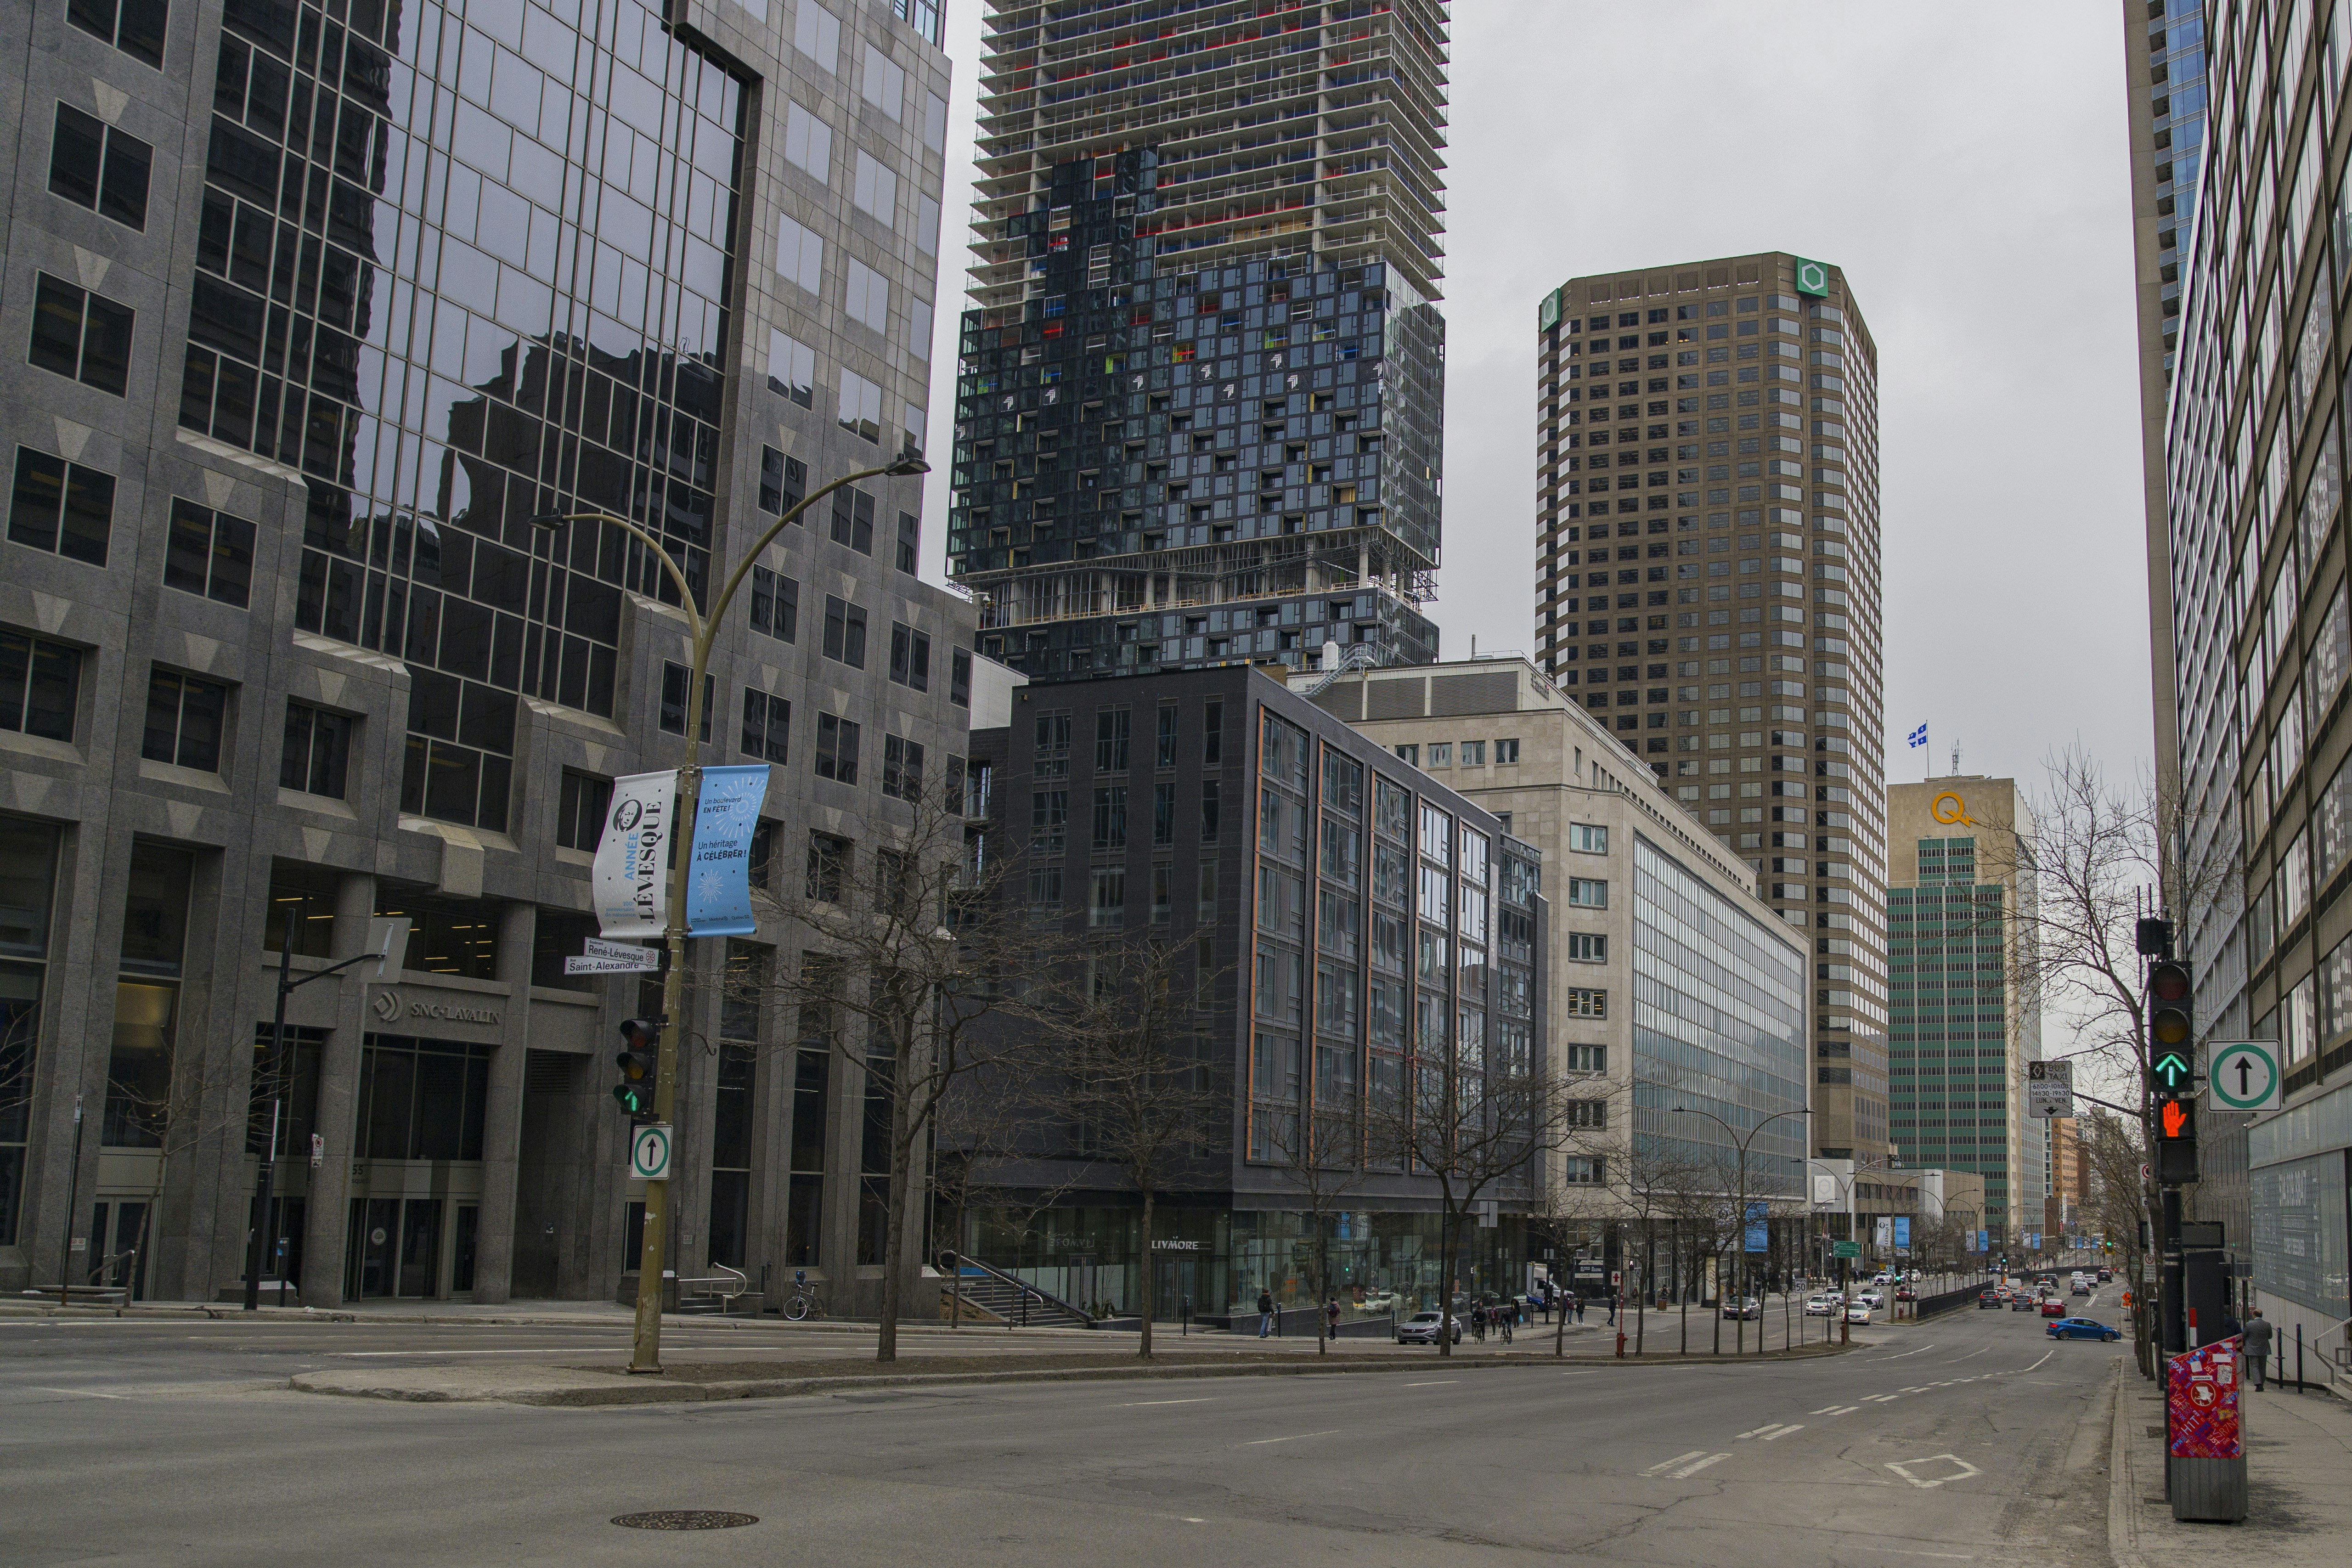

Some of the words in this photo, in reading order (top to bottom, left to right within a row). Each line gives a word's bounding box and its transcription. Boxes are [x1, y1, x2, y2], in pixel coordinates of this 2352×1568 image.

[709, 840, 738, 848] héritage
[625, 832, 639, 880] ANNÉE
[633, 801, 663, 921] LÉVESQUE
[697, 851, 701, 862] À
[589, 945, 643, 963] René-Lévesque
[570, 962, 639, 971] Saint-Alexandre
[1151, 1241, 1199, 1249] LIVMORE
[1796, 1283, 1805, 1291] 50
[2219, 1419, 2235, 1436] R7N
[2210, 1437, 2220, 1446] J5T
